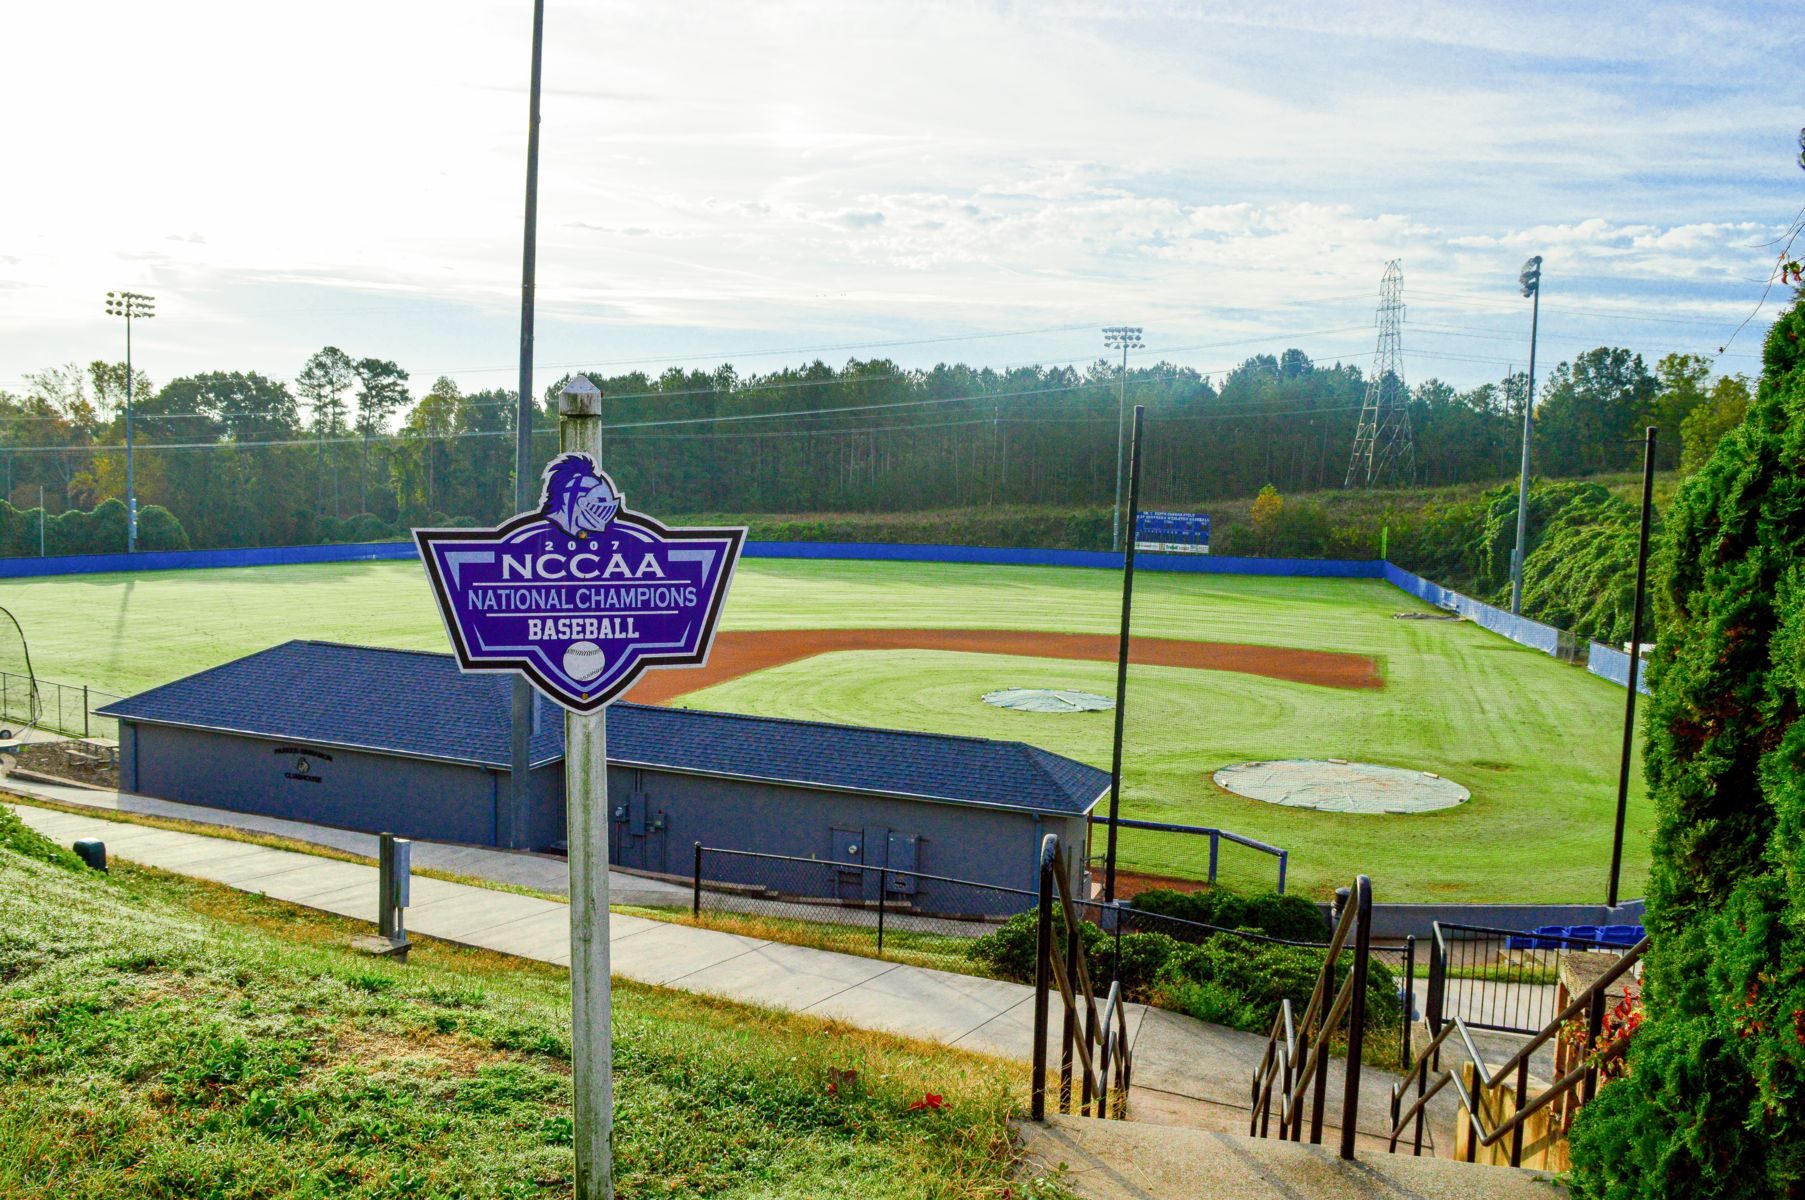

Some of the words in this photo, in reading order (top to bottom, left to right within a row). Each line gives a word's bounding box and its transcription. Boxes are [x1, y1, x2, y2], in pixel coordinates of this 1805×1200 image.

[501, 553, 666, 580] NCCAA
[468, 589, 574, 610] NATIONAL
[576, 586, 697, 609] CHAMPIONS
[528, 617, 640, 641] BASEBALL
